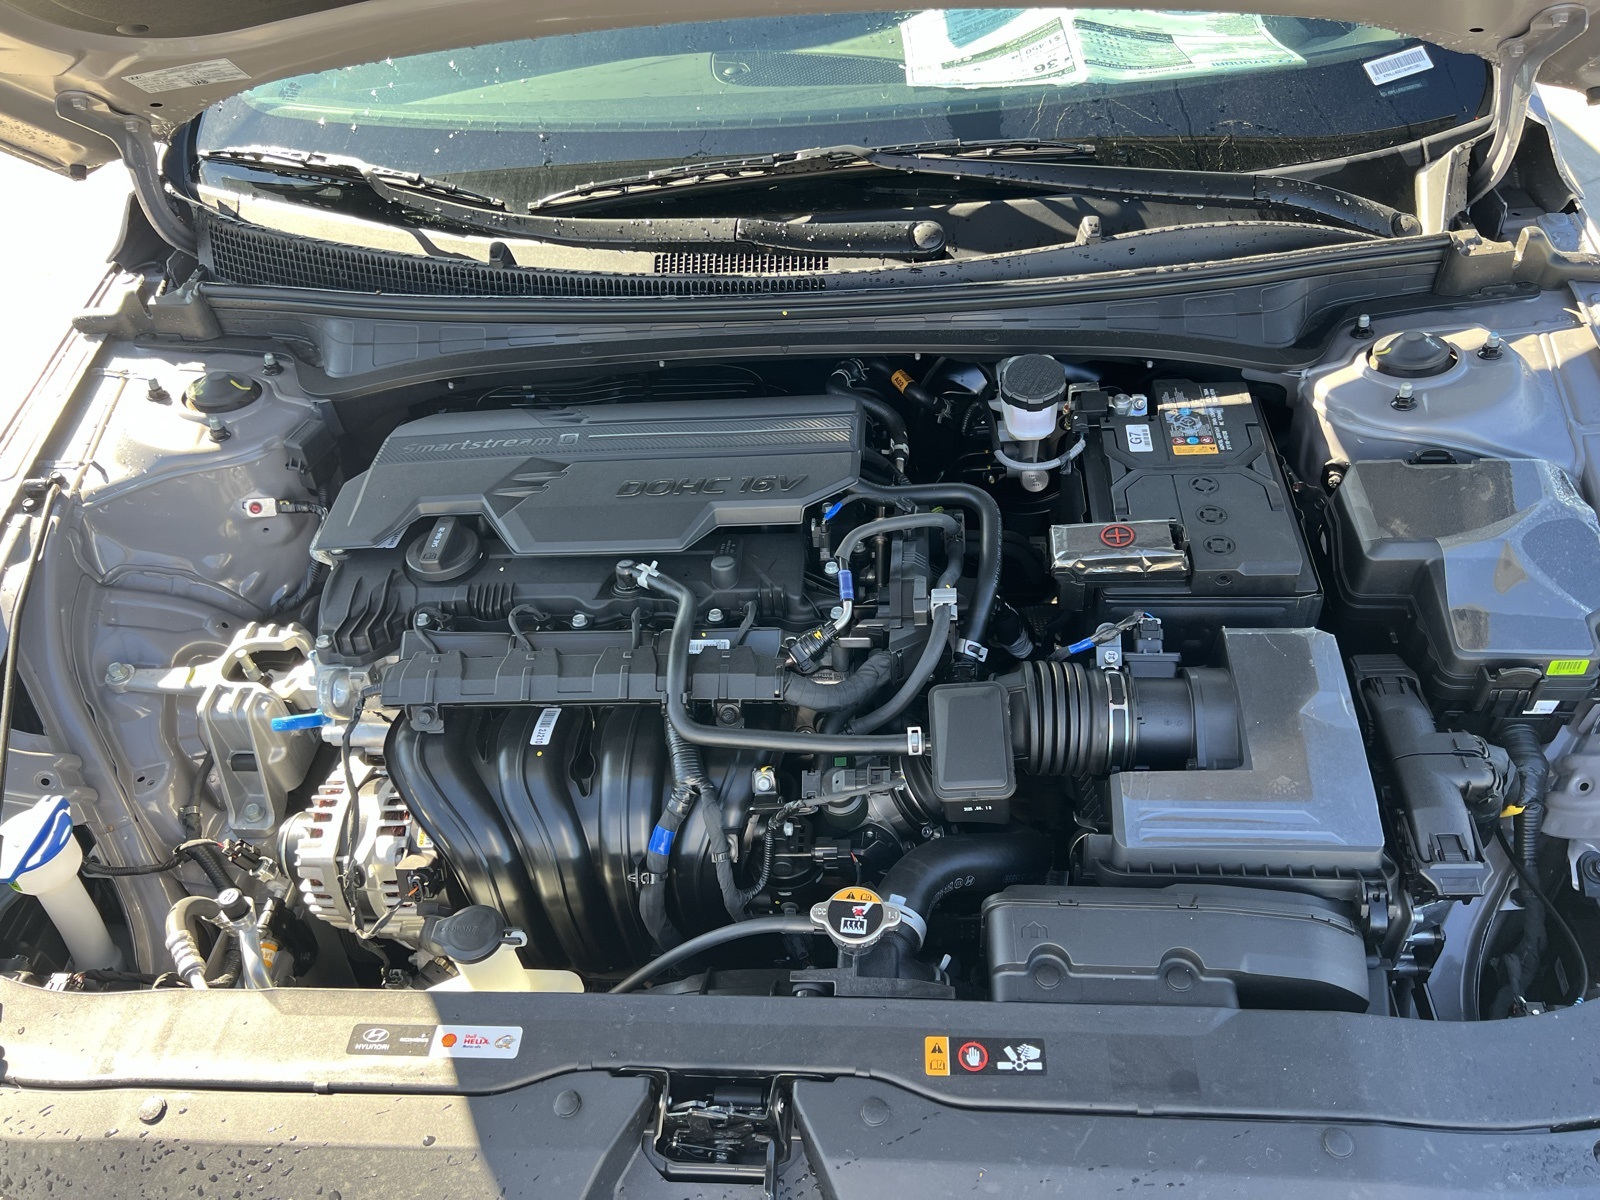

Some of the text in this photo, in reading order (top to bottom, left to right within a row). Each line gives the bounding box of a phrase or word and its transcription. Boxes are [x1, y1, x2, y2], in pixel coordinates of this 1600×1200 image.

[403, 437, 553, 454] Smartstream
[1129, 431, 1143, 445] G7
[615, 474, 809, 498] DOHC 16V
